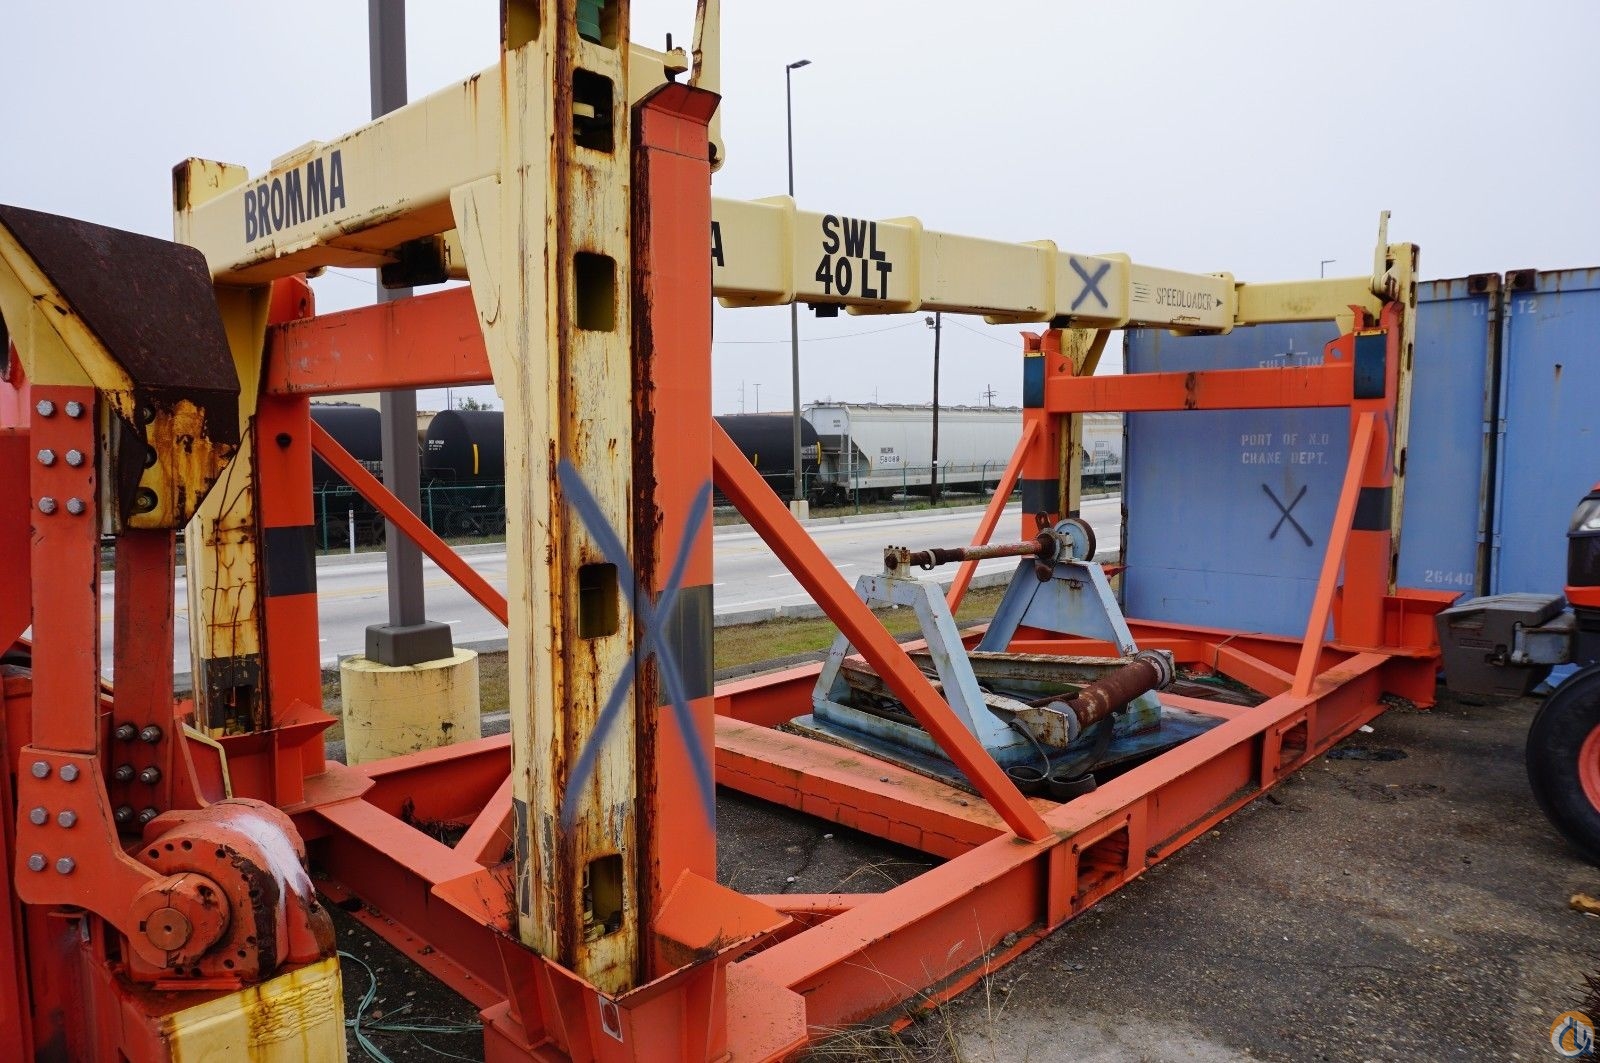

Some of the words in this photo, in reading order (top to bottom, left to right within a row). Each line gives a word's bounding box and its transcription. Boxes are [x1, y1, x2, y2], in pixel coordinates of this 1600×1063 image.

[244, 149, 346, 243] BROMMA
[822, 214, 885, 261] SWL
[815, 254, 853, 295] 40
[861, 258, 892, 300] LT
[1155, 287, 1212, 311] SPEEDLOADER
[1517, 299, 1538, 314] T2
[1241, 433, 1272, 446] PORT
[1282, 433, 1299, 446] OF
[1242, 451, 1281, 465] CRANE
[1424, 569, 1474, 586] 26440
